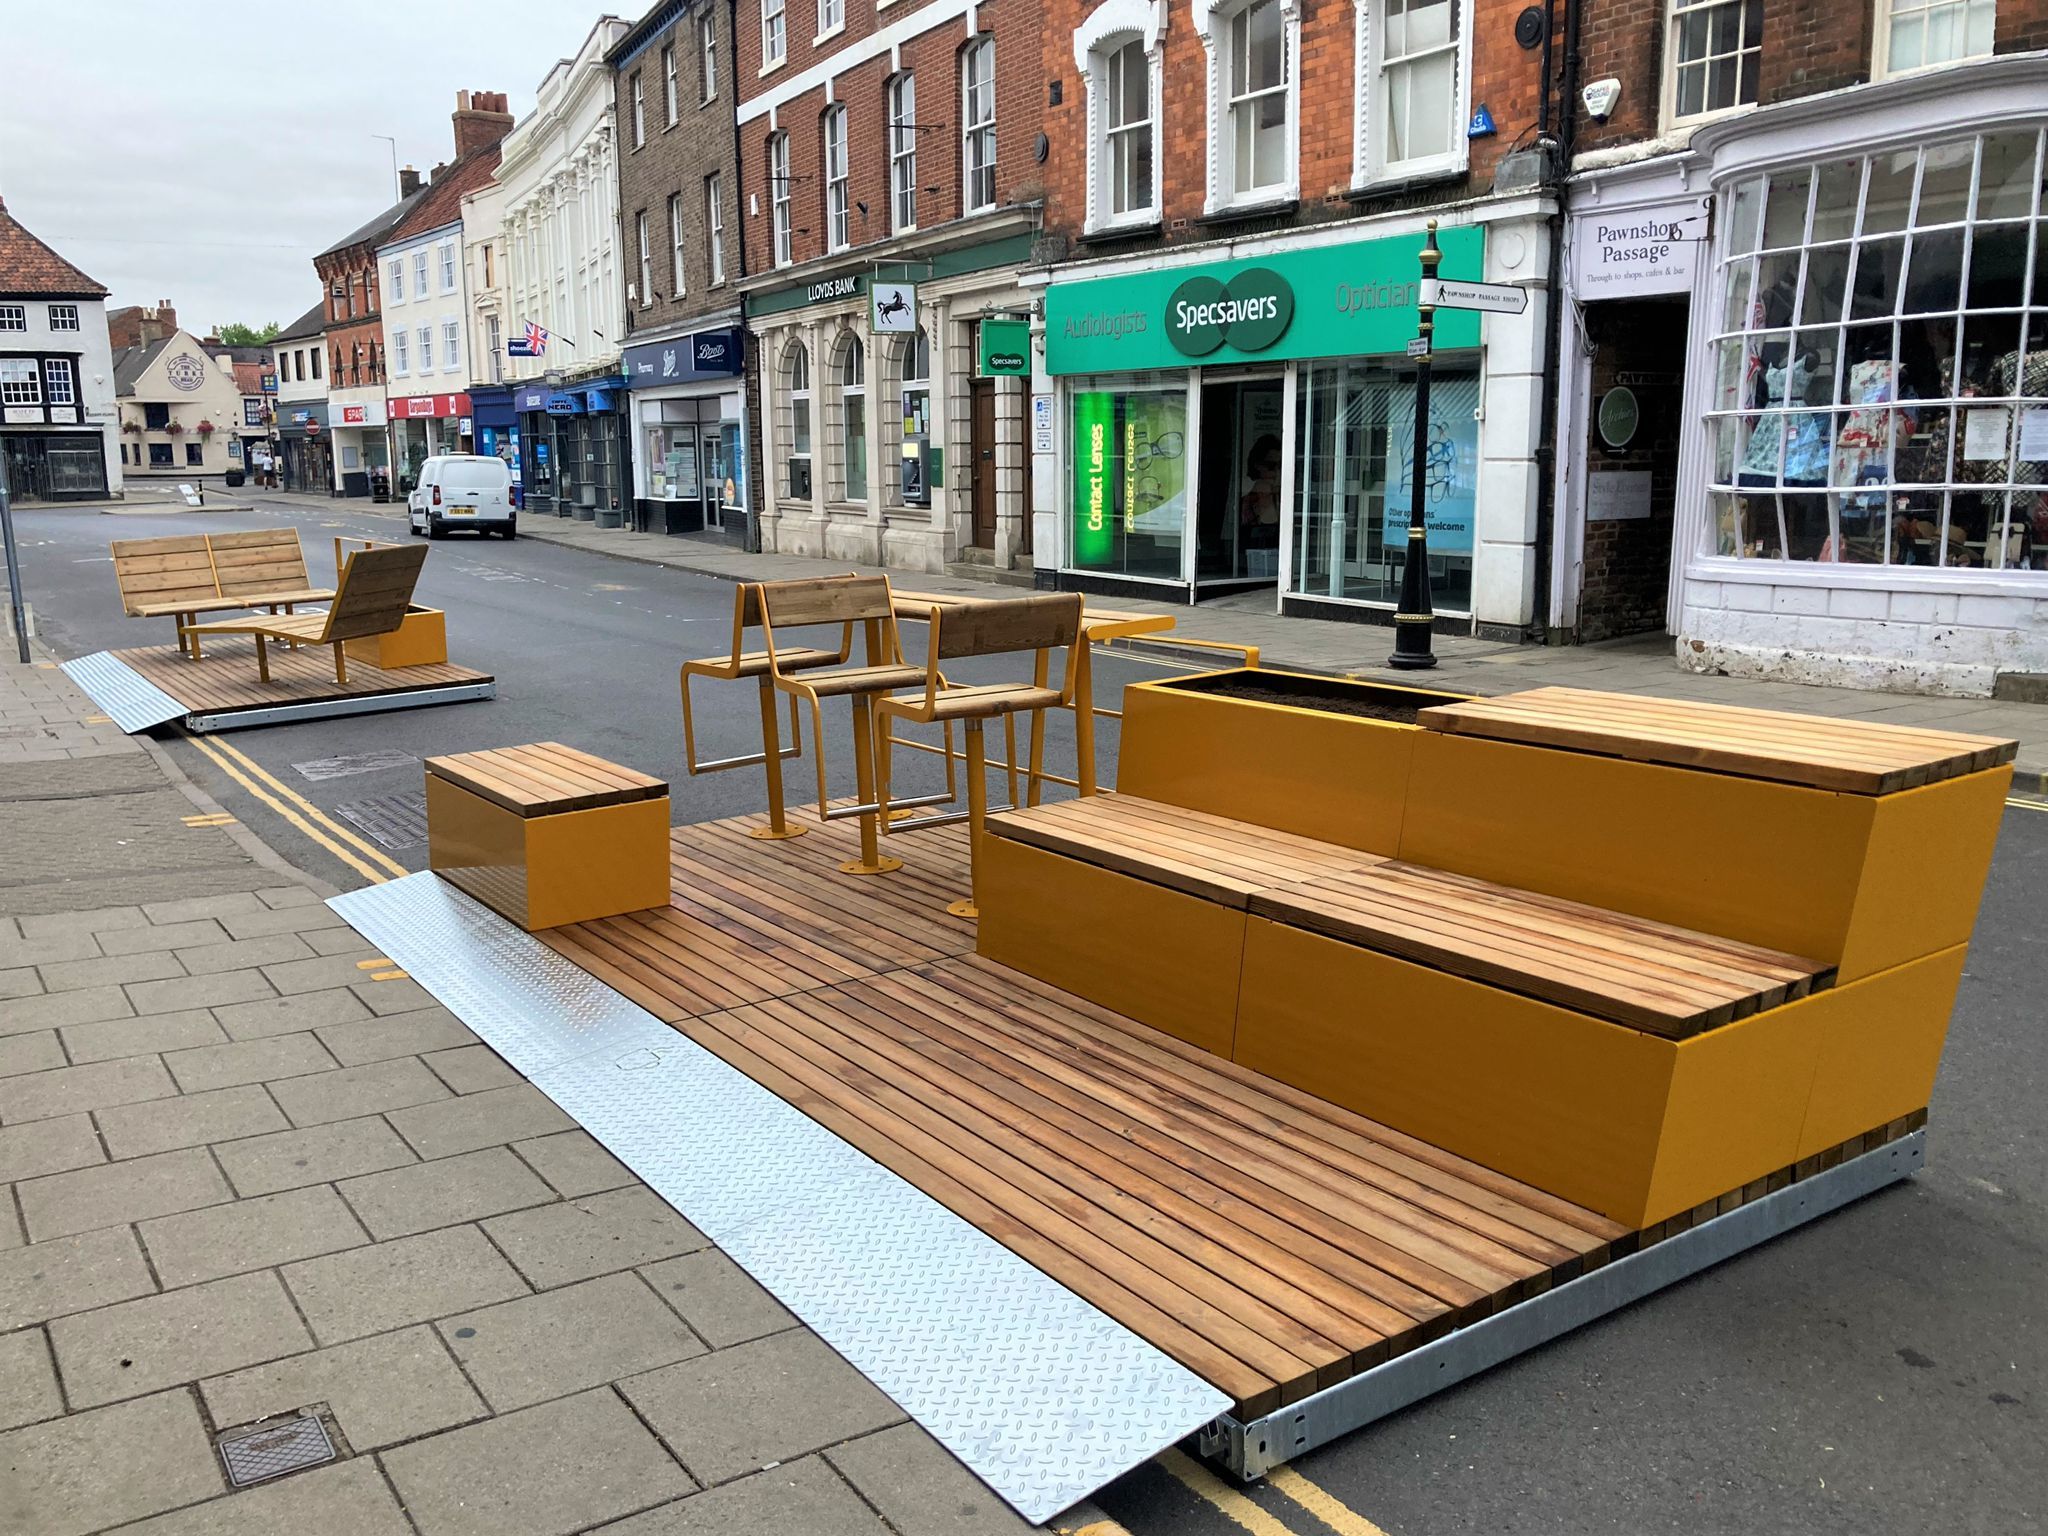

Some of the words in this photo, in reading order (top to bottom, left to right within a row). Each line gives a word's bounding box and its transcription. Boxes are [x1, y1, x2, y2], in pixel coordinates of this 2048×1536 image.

[1597, 220, 1679, 243] Pawnshop
[1602, 244, 1670, 264] Passage
[1586, 272, 1613, 283] Through
[1614, 272, 1622, 280] to
[1665, 266, 1671, 275] &
[1673, 265, 1685, 275] bar
[808, 281, 834, 301] LLOYDS
[834, 276, 856, 296] BANK
[1335, 278, 1420, 318] Optician
[1447, 290, 1476, 299] PAWNSHOP
[1478, 293, 1501, 302] PASSAGE
[1064, 308, 1148, 340] Audiologists
[1176, 295, 1278, 335] Specsavers
[697, 344, 725, 359] Boots
[991, 357, 1022, 366] Specsavers
[347, 407, 364, 420] SPAR
[1088, 423, 1103, 474] Lenses
[1088, 475, 1103, 531] Contact
[1388, 507, 1403, 517] Other
[1427, 521, 1465, 532] welcome
